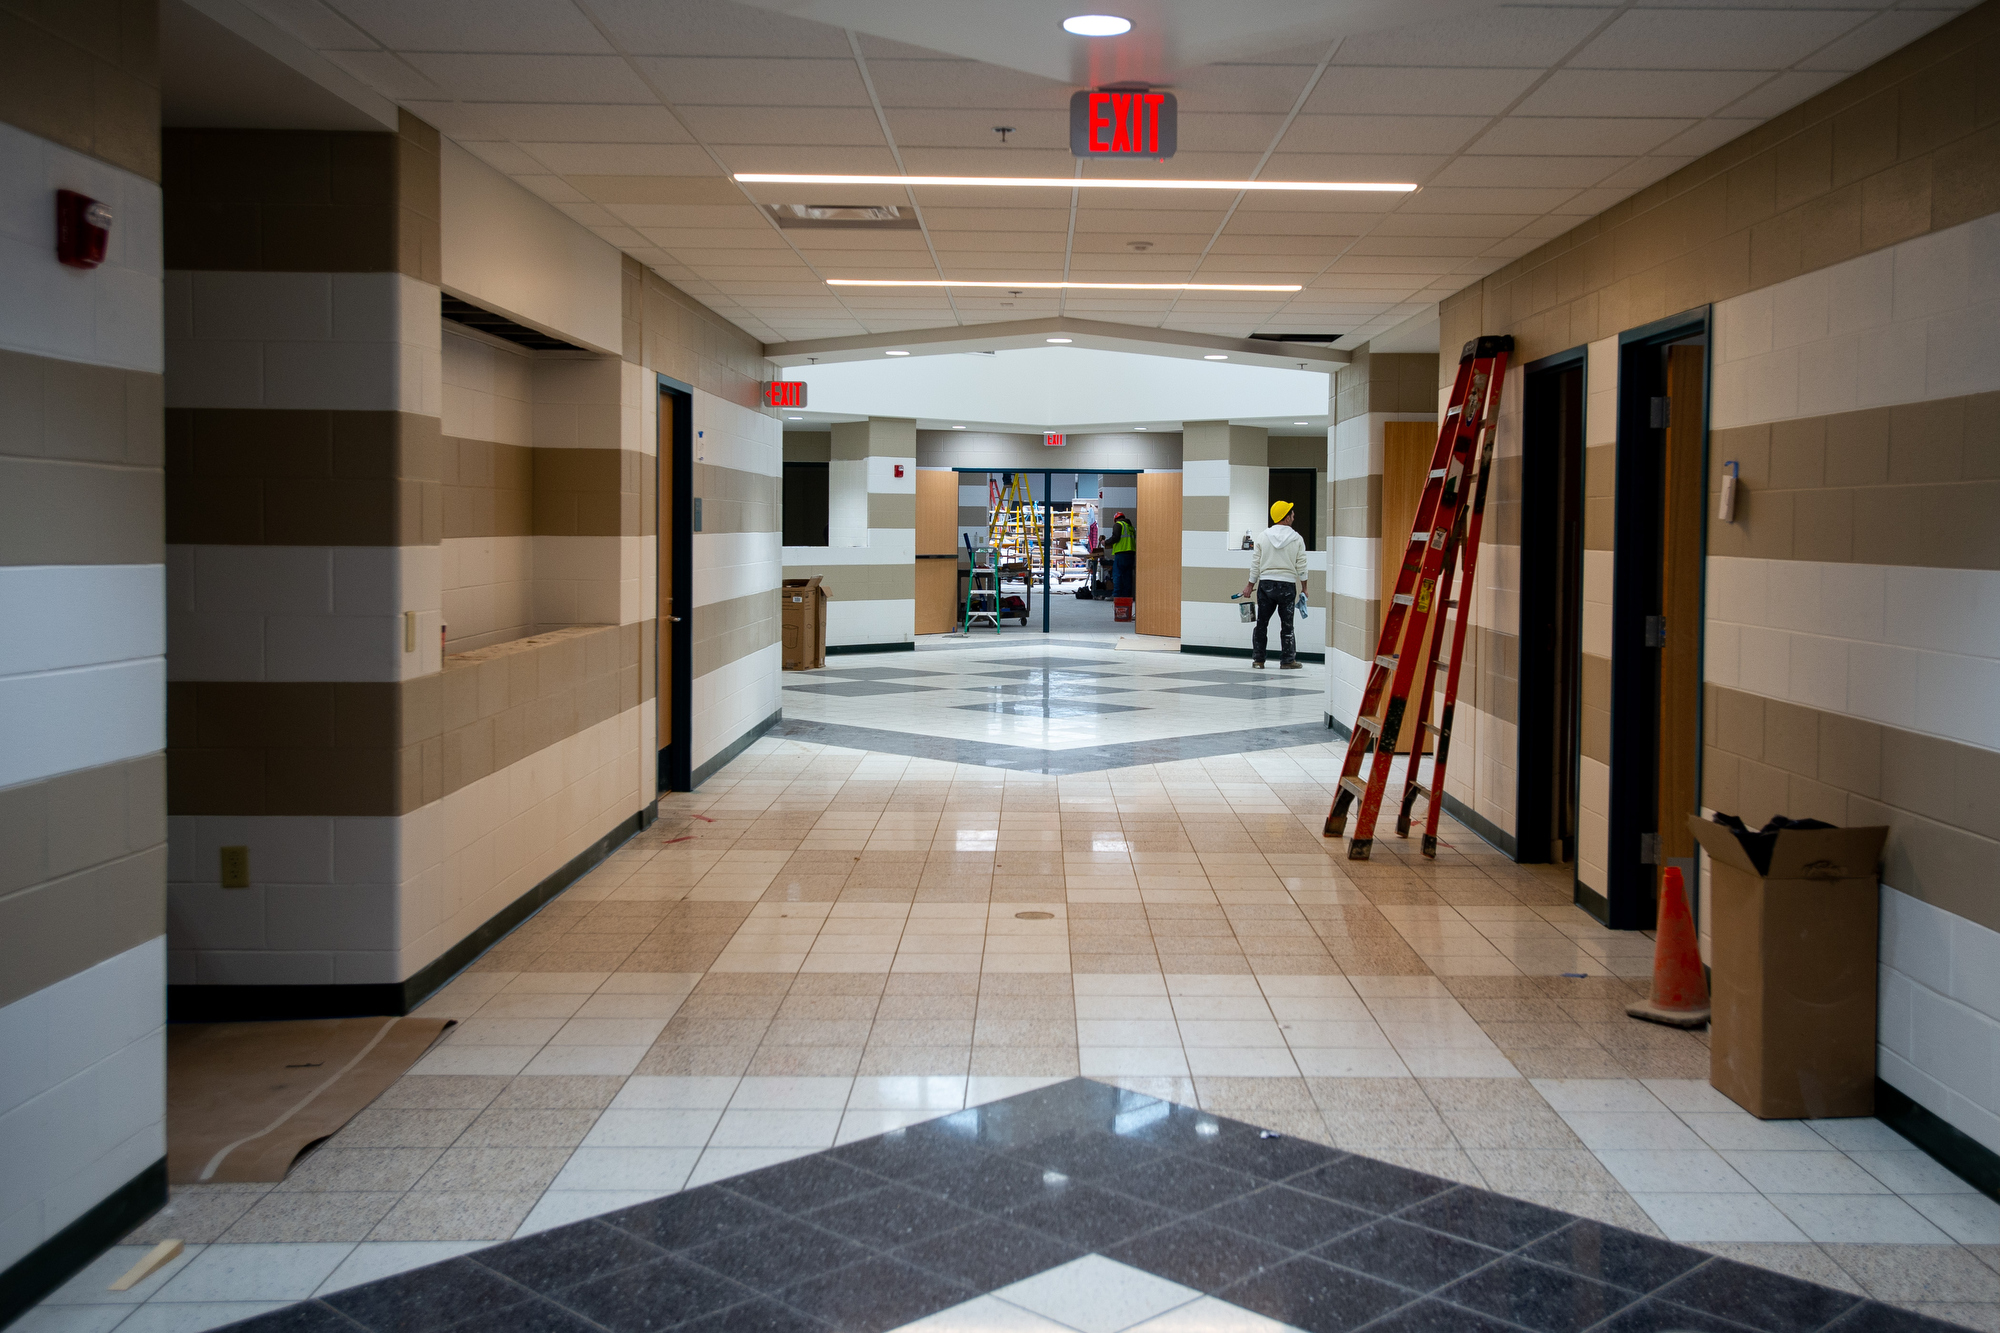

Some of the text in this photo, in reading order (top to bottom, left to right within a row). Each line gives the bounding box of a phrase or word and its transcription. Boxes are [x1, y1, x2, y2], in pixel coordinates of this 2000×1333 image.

[1089, 93, 1165, 153] EXIT
[771, 382, 802, 406] EXIT
[1048, 434, 1063, 445] EXIT
